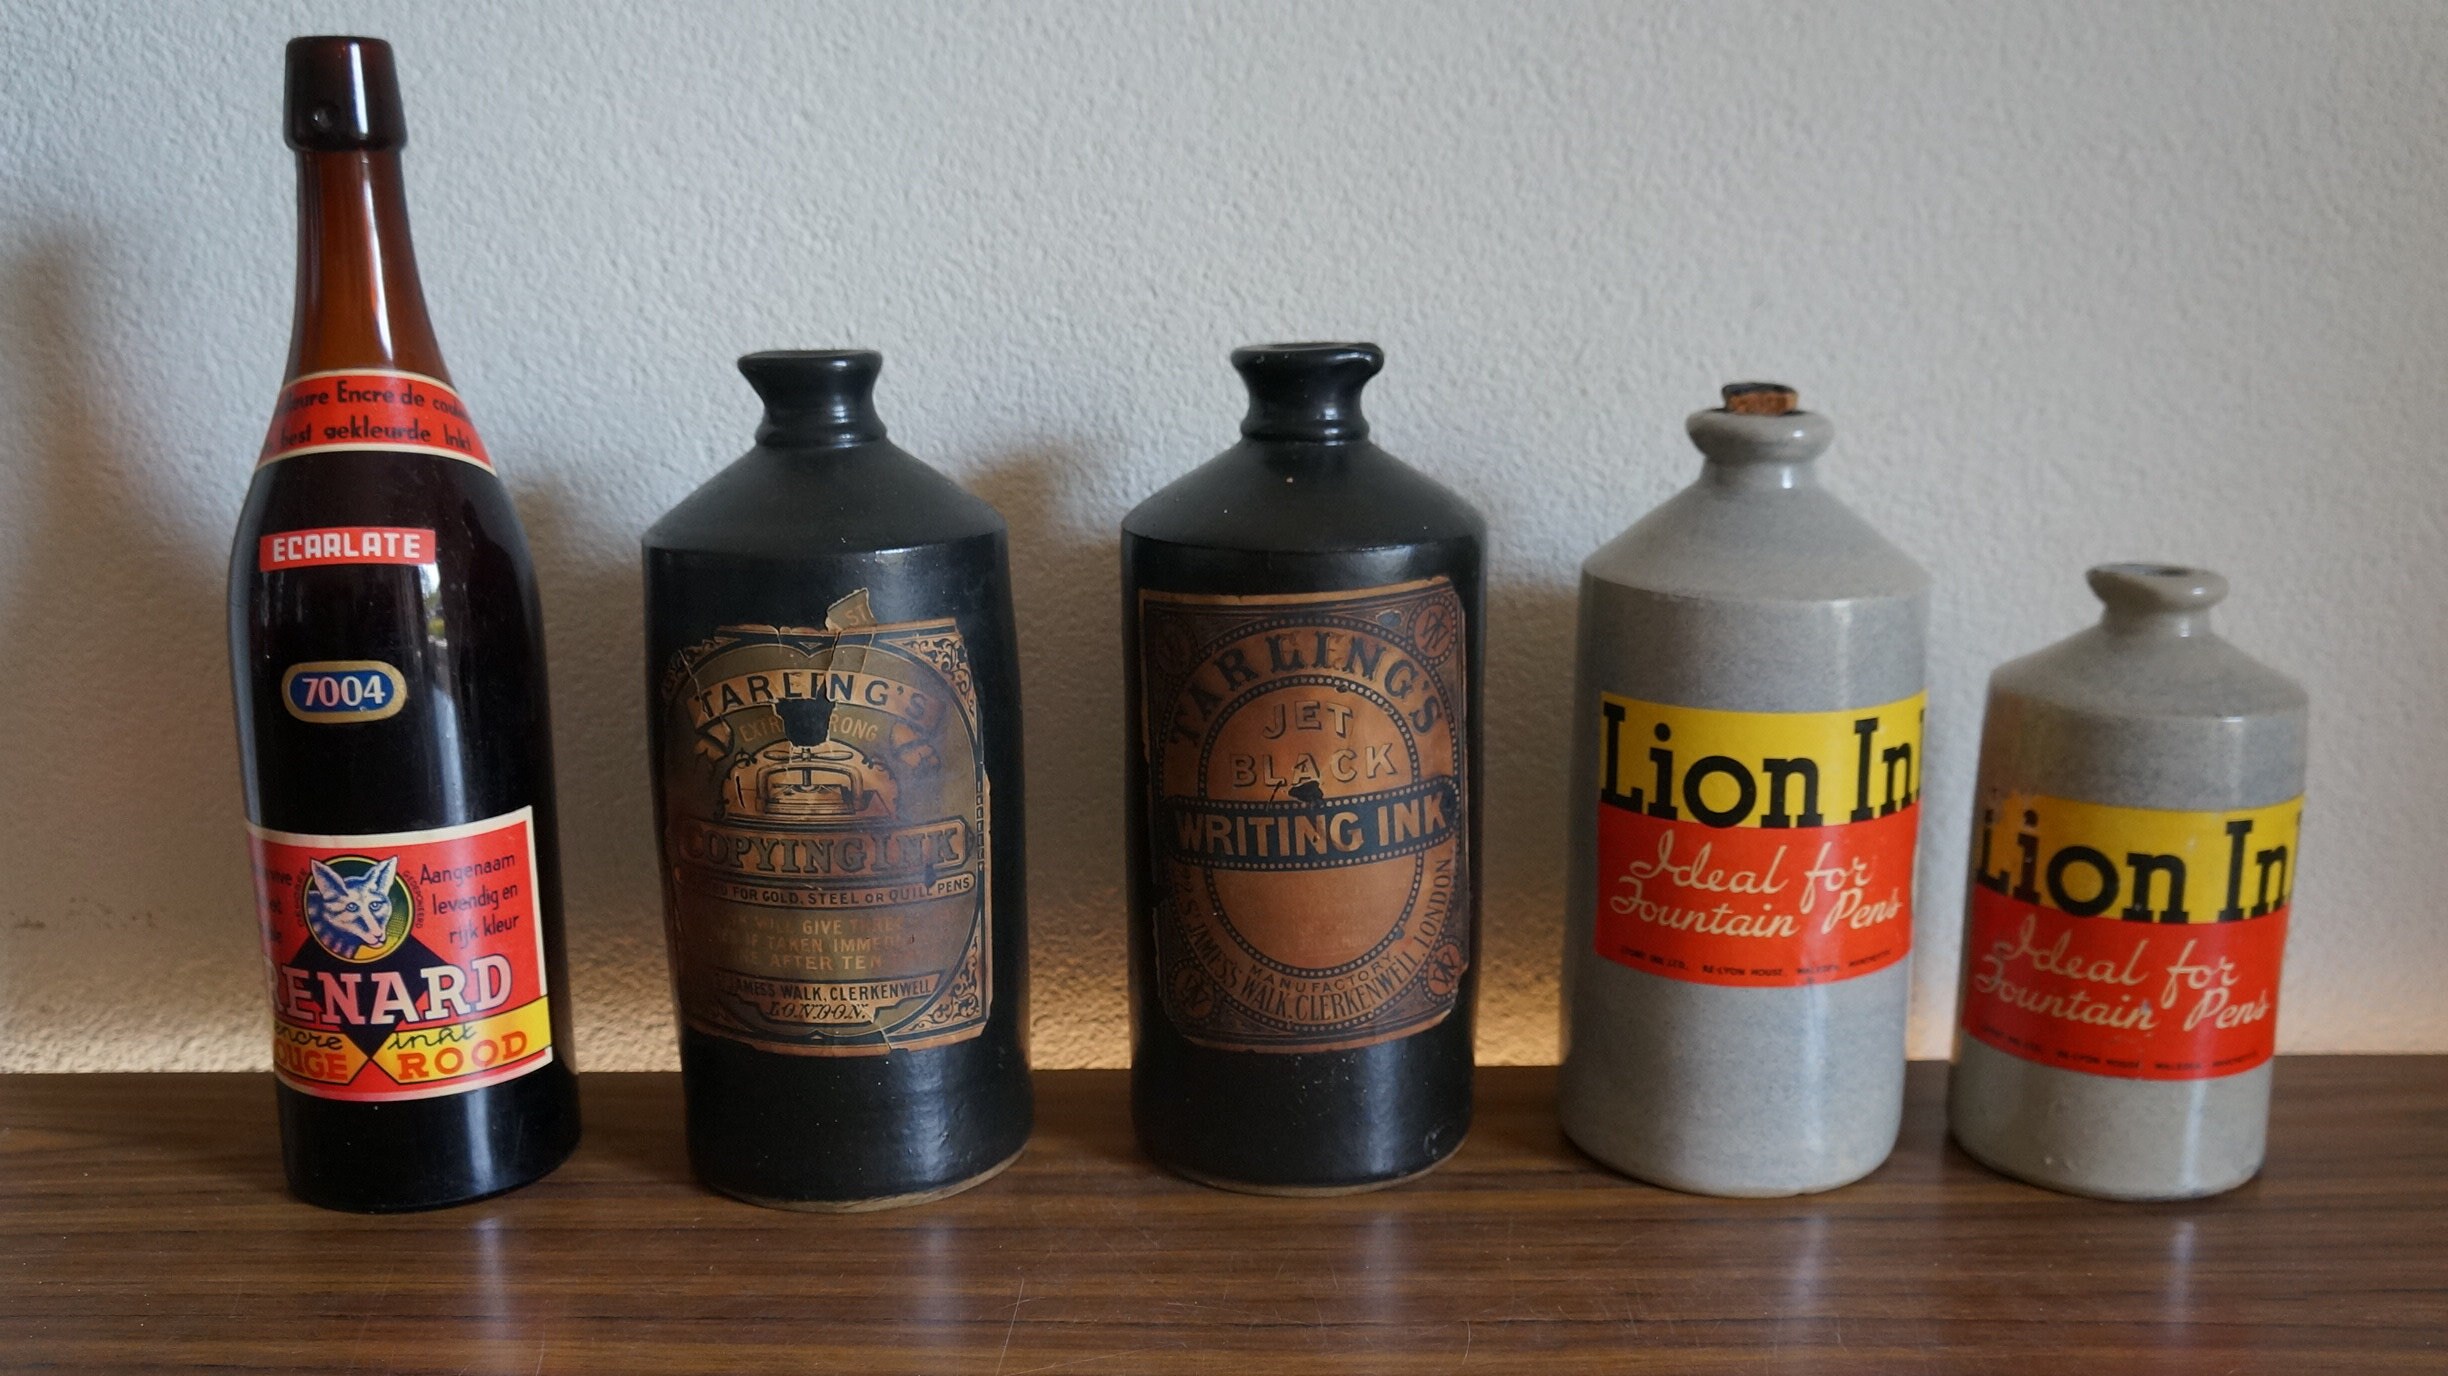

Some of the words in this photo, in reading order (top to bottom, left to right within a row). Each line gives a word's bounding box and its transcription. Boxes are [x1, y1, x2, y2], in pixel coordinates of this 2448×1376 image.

[337, 380, 395, 403] Encre
[401, 383, 425, 407] de
[324, 414, 431, 443] gekleurde
[273, 532, 420, 562] ECARLATE
[302, 675, 386, 707] 7004
[739, 716, 784, 742] EXTR
[829, 712, 880, 741] RONG
[1262, 700, 1353, 738] JET
[1231, 742, 1398, 787] BLACK
[1600, 701, 1824, 828] Lion
[1850, 708, 1923, 823] In
[1175, 810, 1364, 856] WRITING
[1377, 793, 1447, 847] INK
[684, 822, 866, 874] COPYING
[1975, 807, 2190, 924] Lion
[2217, 811, 2301, 923] In
[419, 854, 516, 887] Aangenaam
[1629, 828, 1788, 895] Ideal
[1800, 841, 1873, 915] for
[432, 884, 499, 911] levendig
[502, 883, 518, 900] en
[733, 882, 758, 898] FOR
[808, 892, 859, 905] STEEL
[865, 891, 885, 904] OR
[889, 881, 933, 901] QUILL
[938, 876, 971, 894] PENS
[1413, 857, 1451, 949] LONDON
[1609, 874, 1802, 939] Fountain
[1821, 886, 1904, 936] Pens
[449, 919, 479, 949] rijk
[483, 914, 520, 938] kleur
[802, 919, 843, 936] GIVE
[770, 954, 833, 971] AFTER
[842, 954, 883, 971] TEN
[1992, 913, 2150, 987] Ideal
[2160, 938, 2240, 1011] for
[830, 979, 932, 1002] CLERKENWELL
[1975, 953, 2158, 1032] Fountain
[2182, 986, 2271, 1032] Pens
[396, 1030, 528, 1081] ROOD
